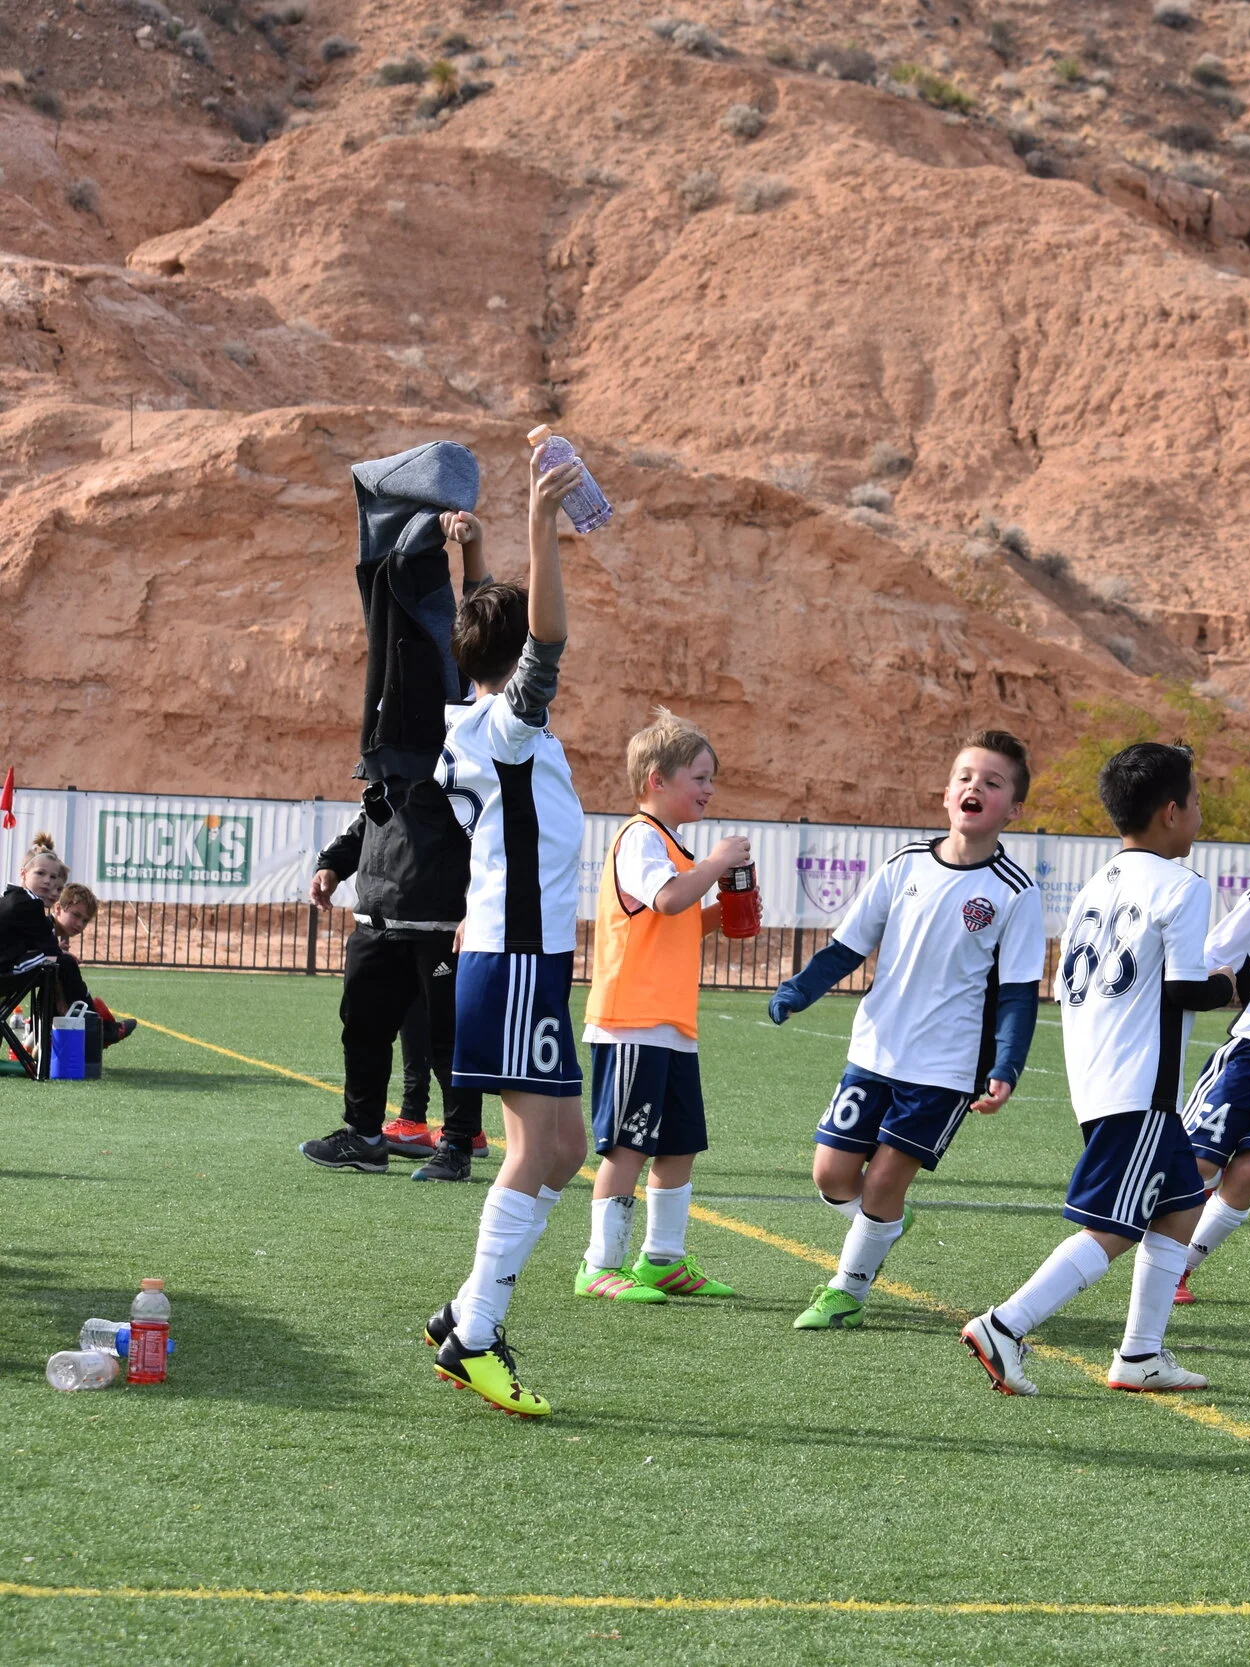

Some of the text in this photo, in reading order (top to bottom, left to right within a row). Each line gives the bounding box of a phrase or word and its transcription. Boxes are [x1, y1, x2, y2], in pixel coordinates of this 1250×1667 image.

[105, 815, 246, 869] DICK'S
[106, 866, 183, 880] SPORTING
[797, 858, 866, 872] UTAH
[963, 904, 992, 925] USA
[1062, 900, 1143, 1007] 68
